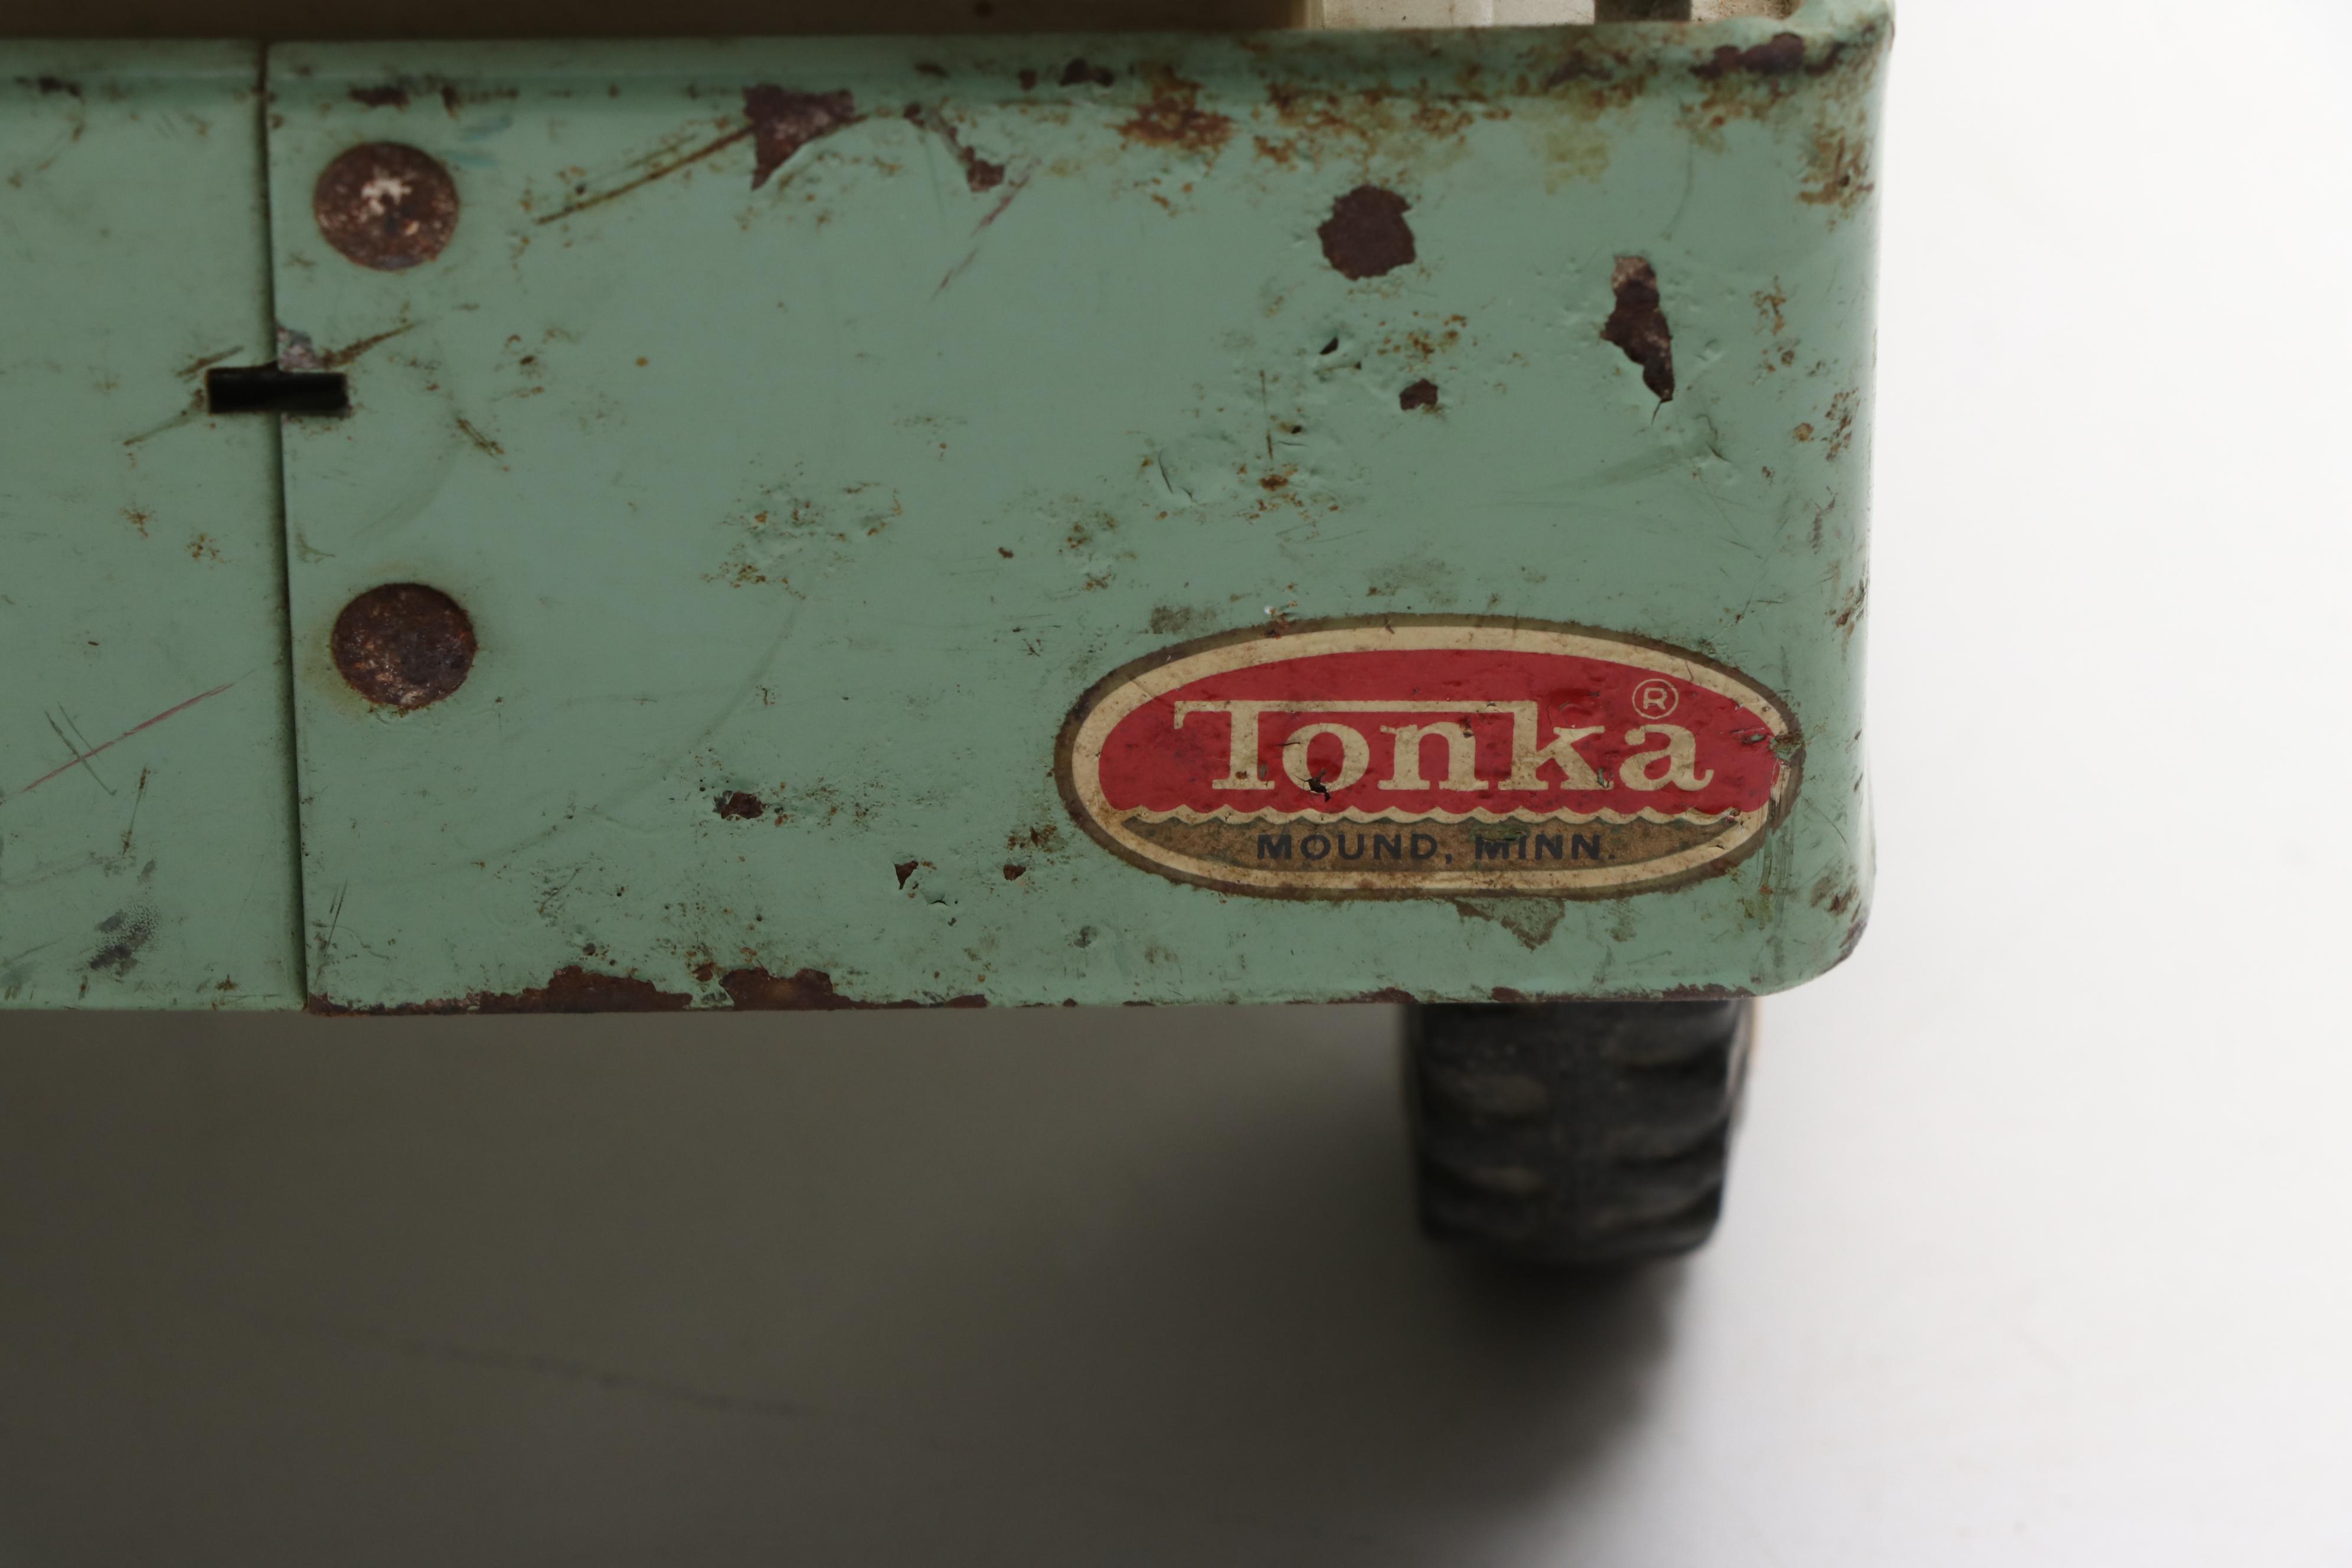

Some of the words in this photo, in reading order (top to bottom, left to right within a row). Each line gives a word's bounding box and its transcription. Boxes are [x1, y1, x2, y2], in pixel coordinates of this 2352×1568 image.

[1173, 700, 1714, 792] Tonka
[1256, 832, 1453, 865] MOUND,
[1476, 832, 1617, 861] MINN.
